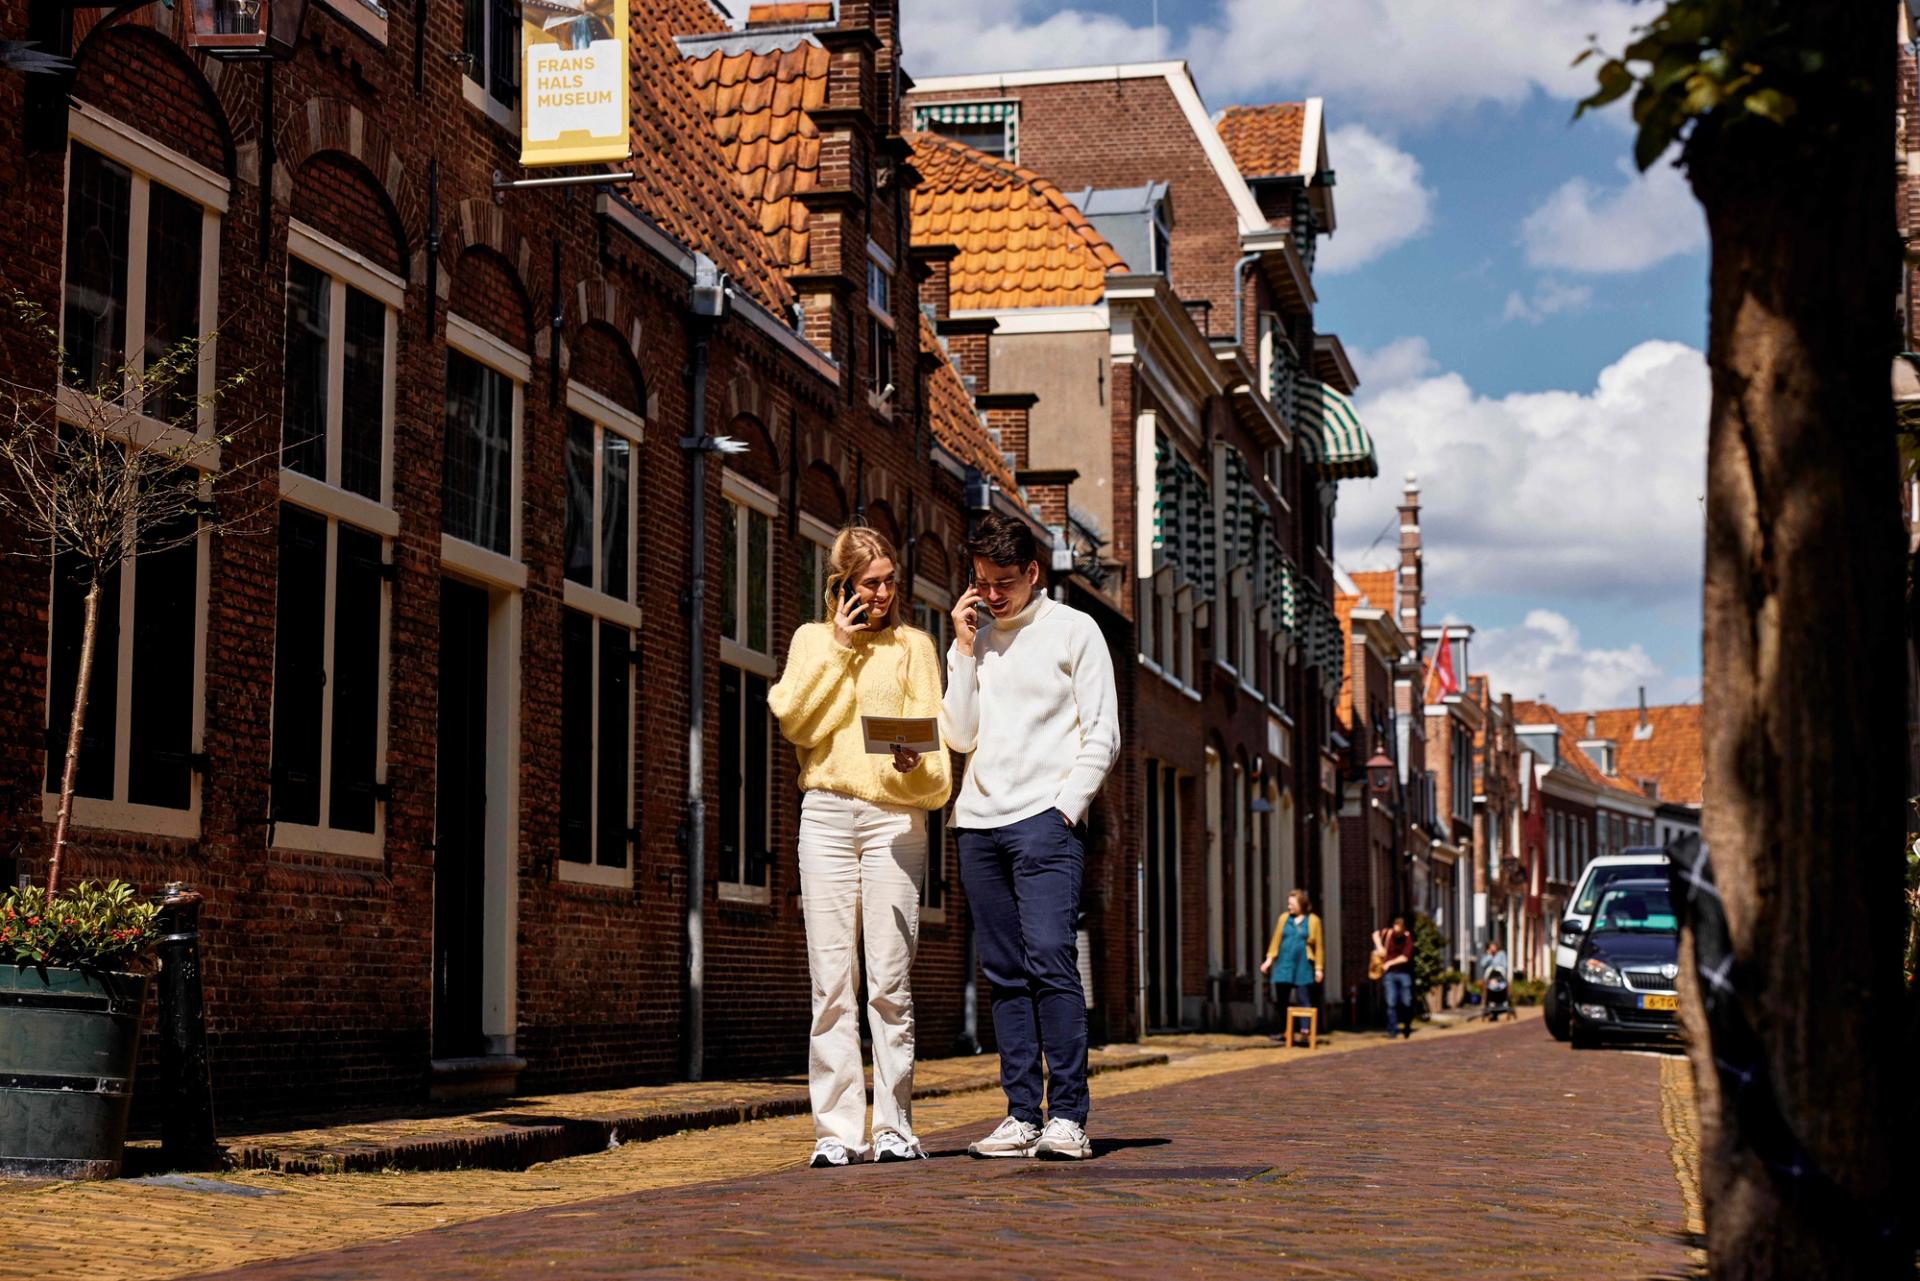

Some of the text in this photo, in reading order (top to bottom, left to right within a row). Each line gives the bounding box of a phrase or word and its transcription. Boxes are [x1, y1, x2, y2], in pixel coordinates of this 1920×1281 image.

[537, 56, 595, 73] FRANS
[537, 74, 583, 90] HALS
[537, 90, 612, 108] MUSEUM
